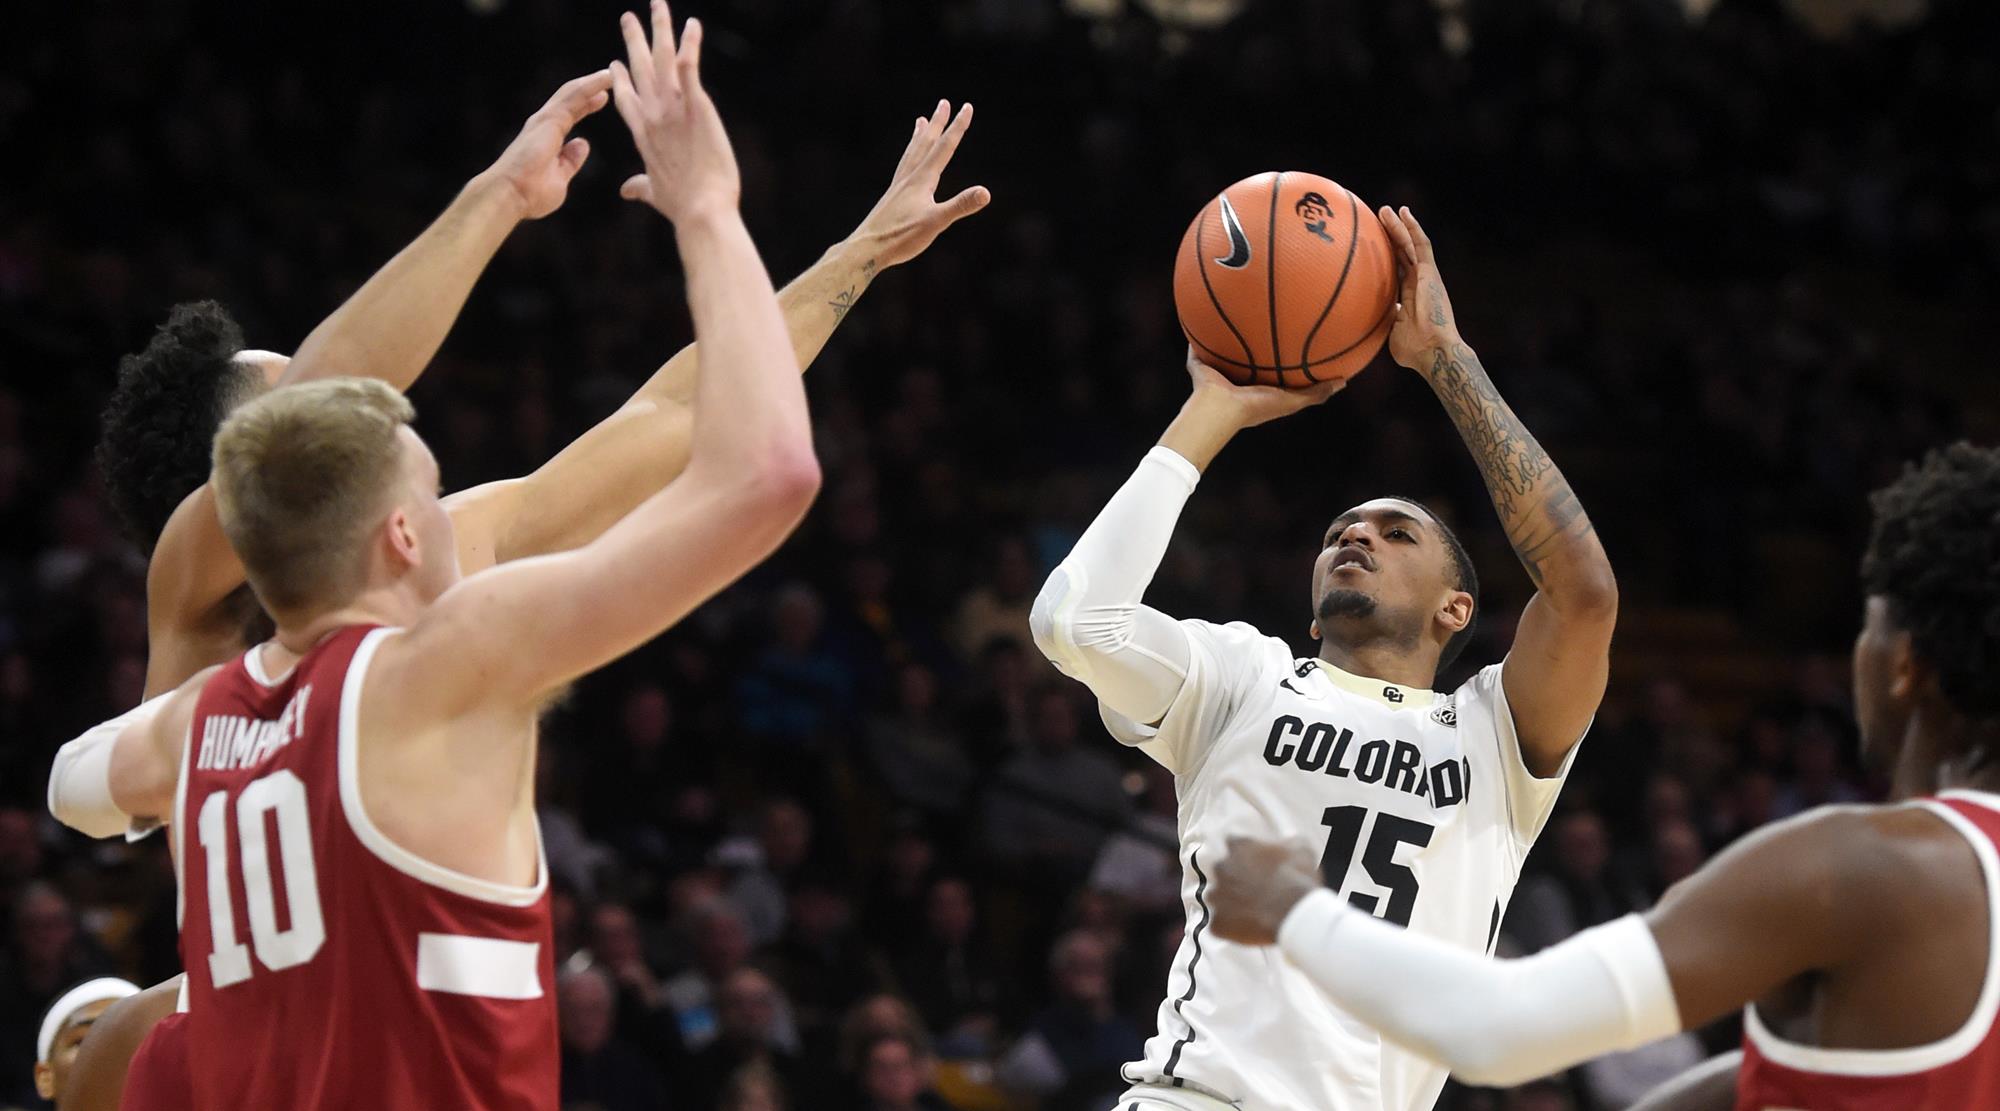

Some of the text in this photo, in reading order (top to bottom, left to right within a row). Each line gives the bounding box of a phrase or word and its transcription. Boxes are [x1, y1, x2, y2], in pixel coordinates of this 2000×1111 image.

[196, 683, 313, 770] HUMPEY
[198, 769, 326, 990] 10
[1320, 805, 1435, 929] 15
